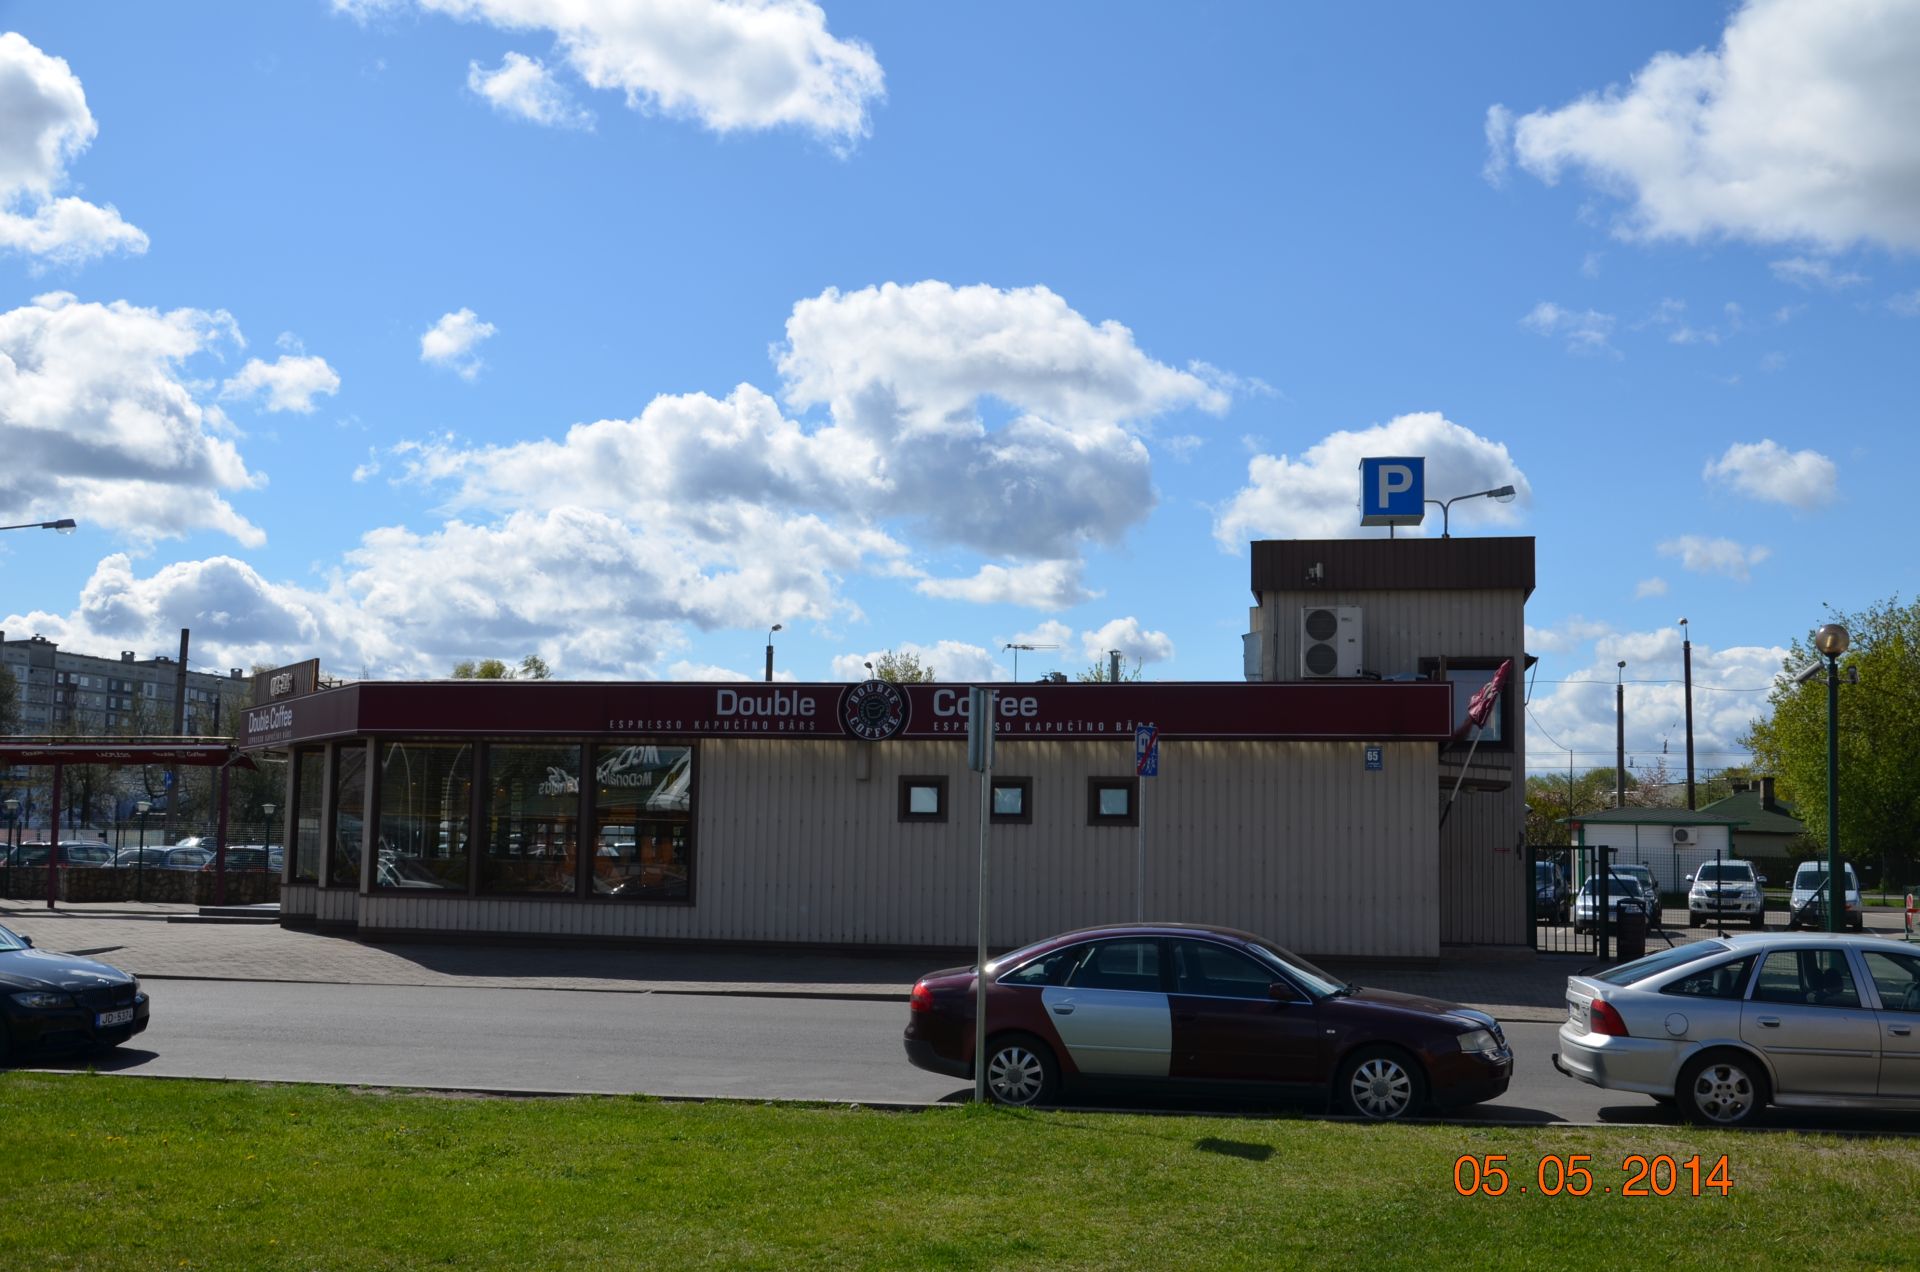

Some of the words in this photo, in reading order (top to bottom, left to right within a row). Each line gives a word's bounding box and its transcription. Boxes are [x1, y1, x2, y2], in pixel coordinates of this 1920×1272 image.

[1378, 464, 1413, 509] P
[716, 689, 816, 717] Double
[850, 683, 899, 704] DOUBLE
[932, 688, 1038, 718] Cofee
[248, 709, 270, 734] Double
[270, 704, 294, 730] Coffee
[609, 719, 682, 730] ESPRESSO
[693, 718, 769, 731] KAPUČĪNO
[778, 718, 816, 731] BĀRS
[849, 715, 899, 738] COFFEE
[933, 721, 1012, 732] ESPRSO
[1025, 719, 1105, 732] KAPUČĪNO
[1367, 751, 1379, 761] 65
